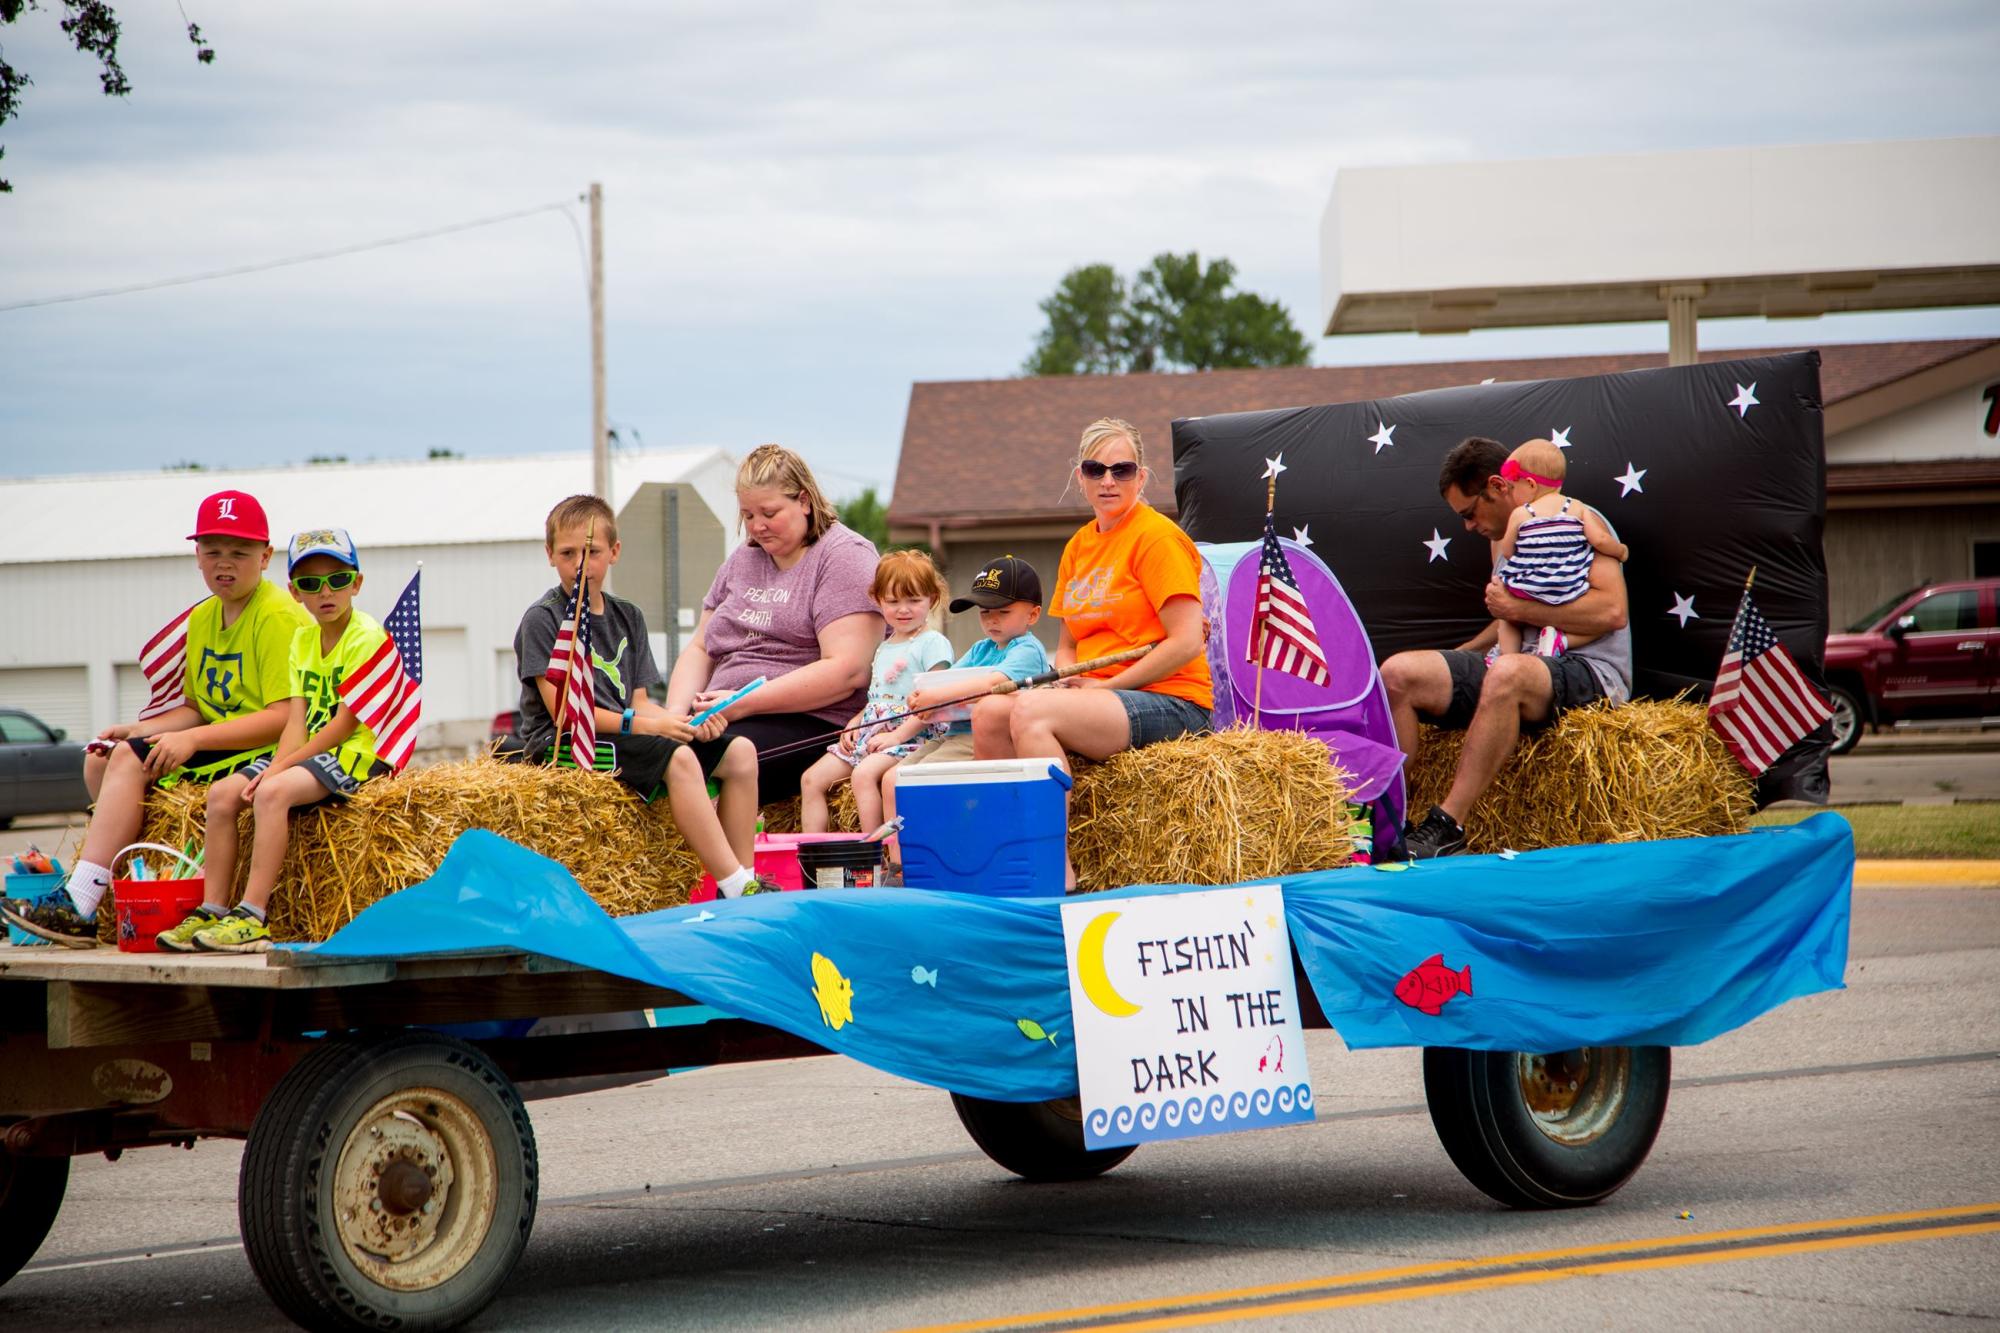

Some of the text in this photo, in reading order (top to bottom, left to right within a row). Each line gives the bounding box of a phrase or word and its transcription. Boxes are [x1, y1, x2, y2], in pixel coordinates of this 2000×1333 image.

[217, 498, 238, 520] L
[737, 608, 772, 626] EARTH
[773, 588, 791, 603] ON
[1137, 919, 1255, 976] FISHIN'
[1171, 990, 1286, 1034] IN THE
[1131, 1050, 1219, 1094] DARK
[446, 1051, 537, 1233] INTEGRITY
[304, 1121, 402, 1329] GOODYEAR
